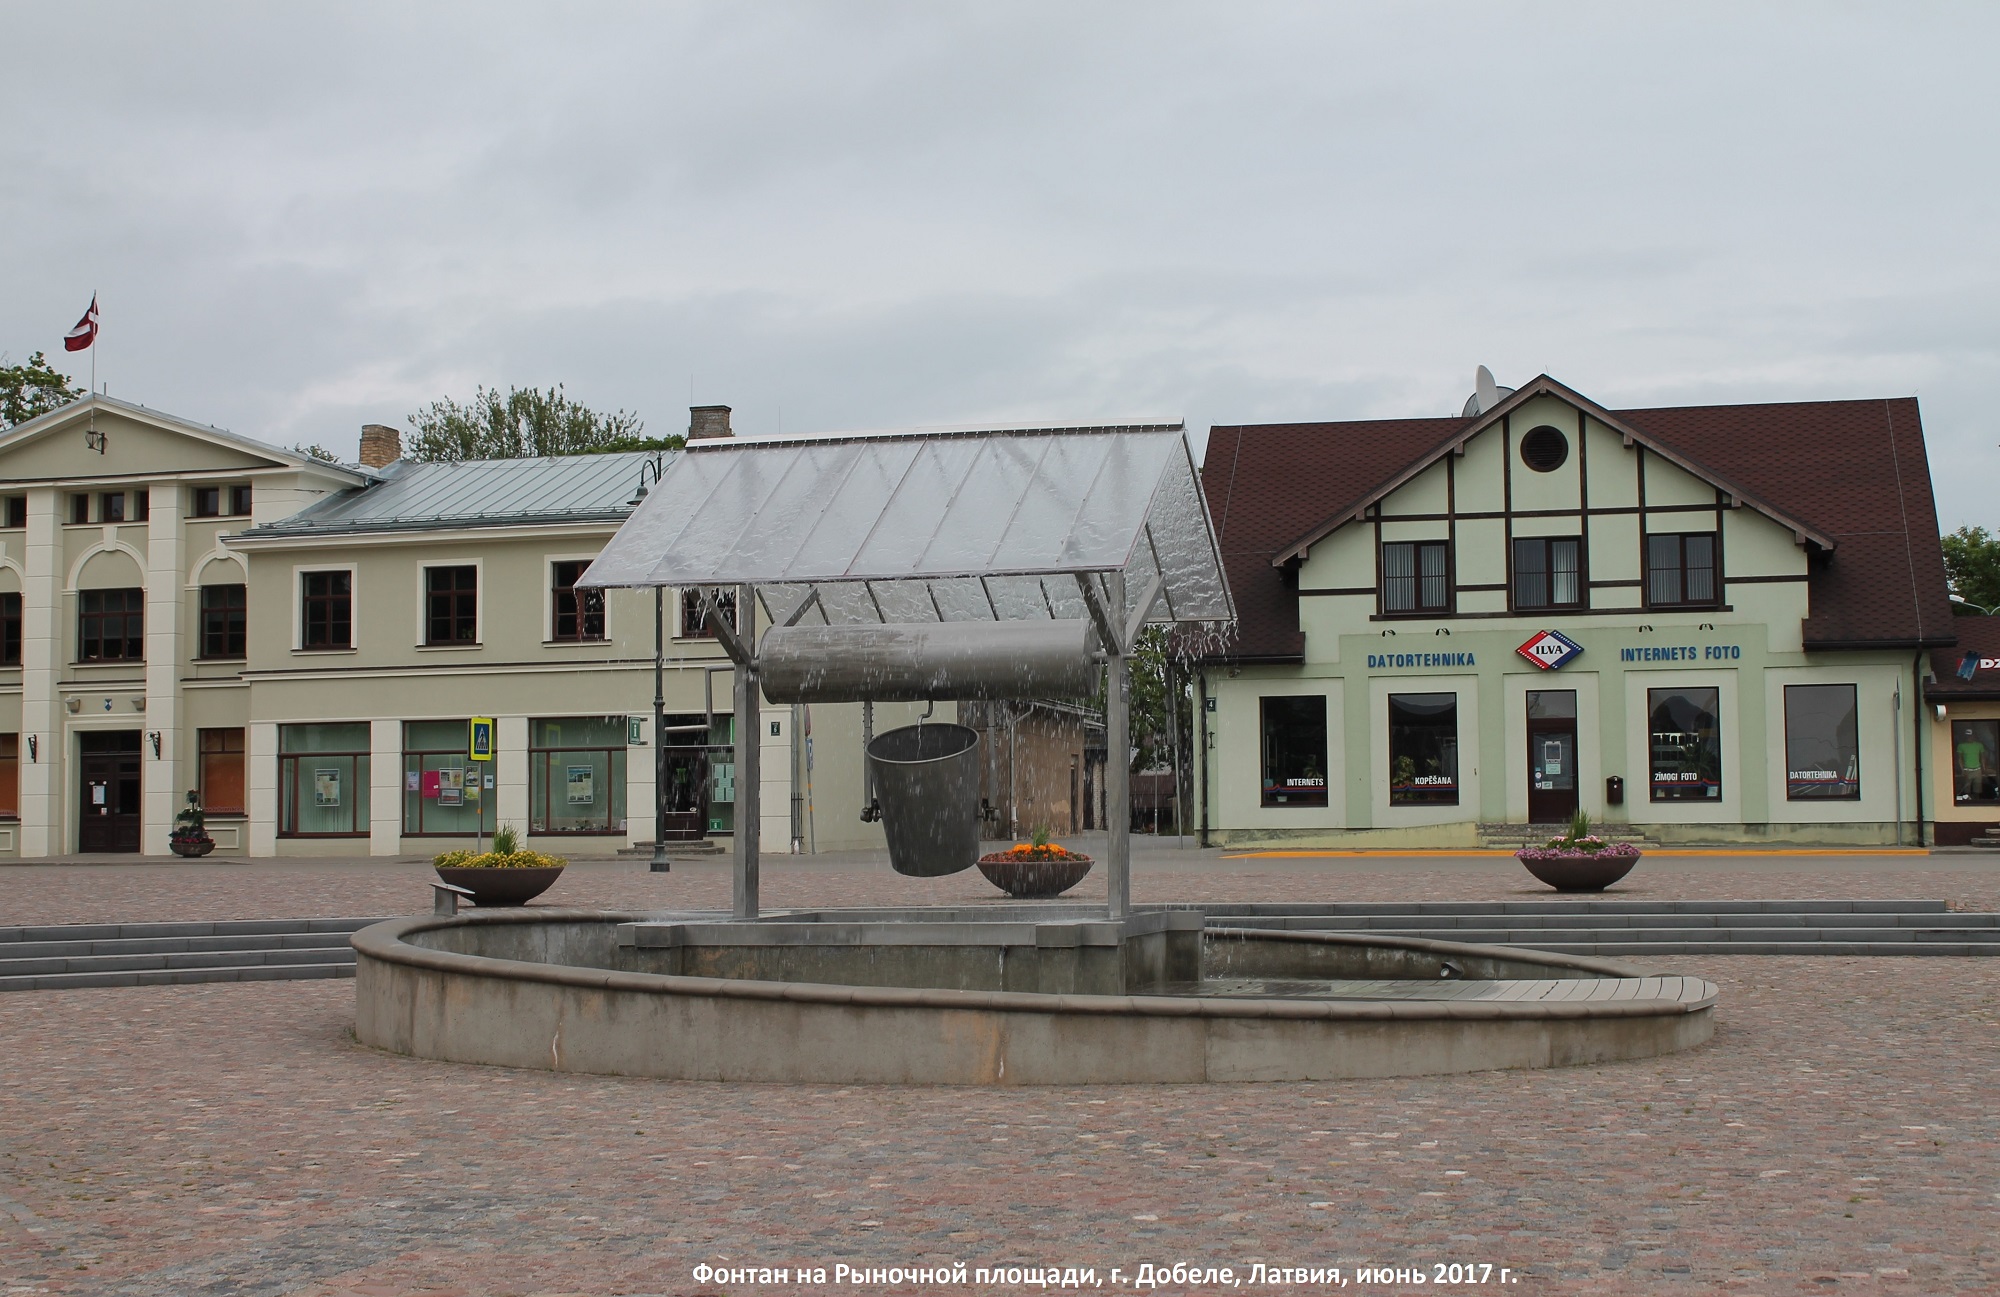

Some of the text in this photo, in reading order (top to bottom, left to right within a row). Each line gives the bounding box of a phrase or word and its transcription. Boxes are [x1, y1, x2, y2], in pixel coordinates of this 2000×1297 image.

[1535, 645, 1563, 655] ILVA
[1621, 645, 1740, 661] INTERNETS FOTO
[1368, 653, 1475, 668] DATORTEHNIKA
[1680, 772, 1697, 781] FOTO
[1789, 770, 1837, 779] DATORTEHNIKA
[1286, 778, 1324, 787] INTERNETS
[1414, 775, 1452, 785] KOPĒŠANA
